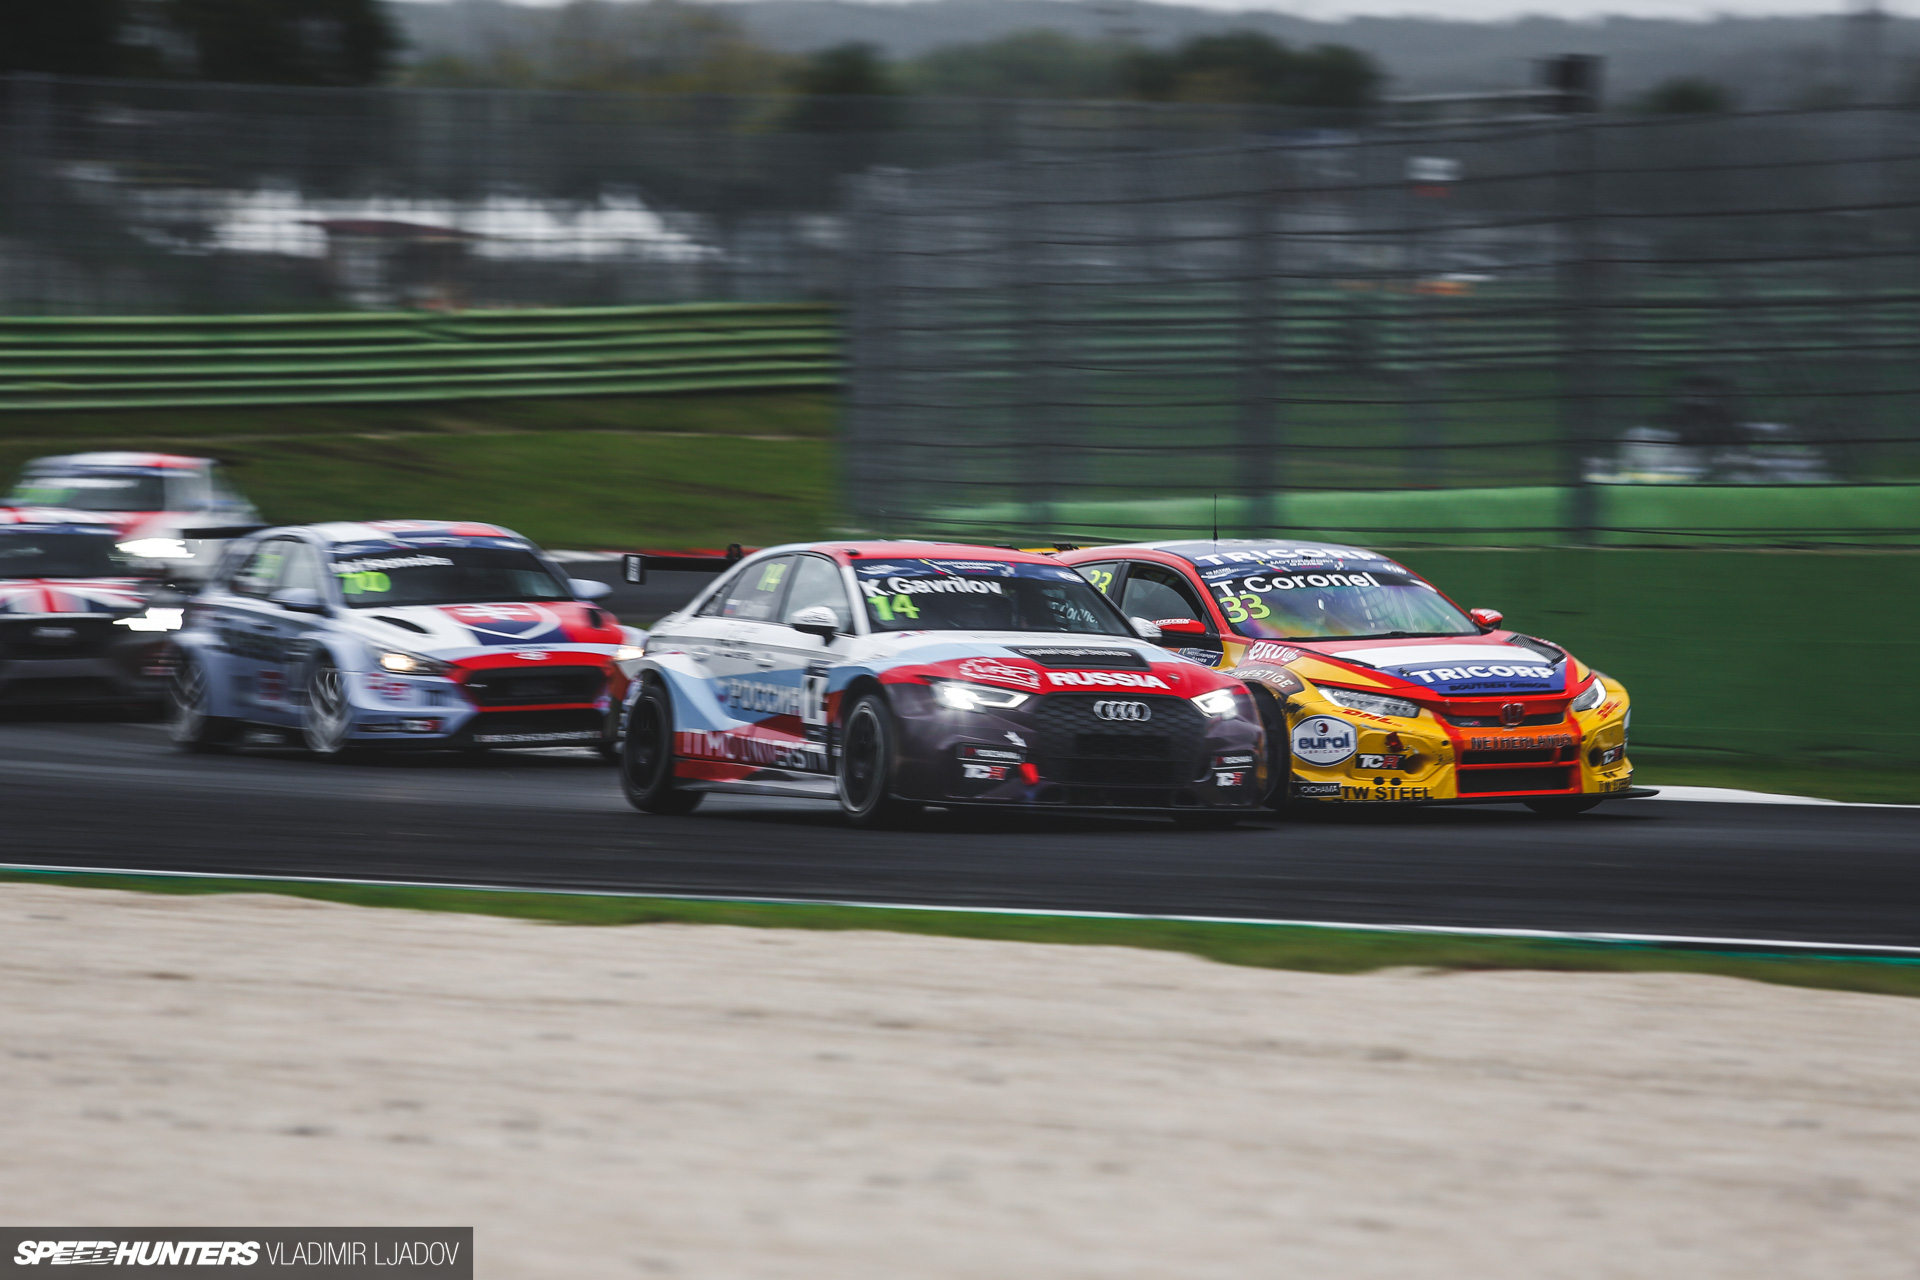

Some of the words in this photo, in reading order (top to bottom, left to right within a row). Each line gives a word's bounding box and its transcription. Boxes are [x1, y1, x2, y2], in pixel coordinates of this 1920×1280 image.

[858, 574, 1003, 598] K.Gavrilov
[1209, 571, 1381, 598] T.Coronel
[866, 593, 921, 621] 14
[1219, 593, 1271, 624] 33
[1044, 671, 1172, 690] RUSSIA
[1403, 665, 1555, 684] TRICORP
[1298, 732, 1351, 750] eurol
[1469, 734, 1573, 751] NETHERLANDS
[1360, 754, 1401, 769] TCR
[1340, 786, 1370, 800] TW
[1375, 786, 1434, 801] STEEL
